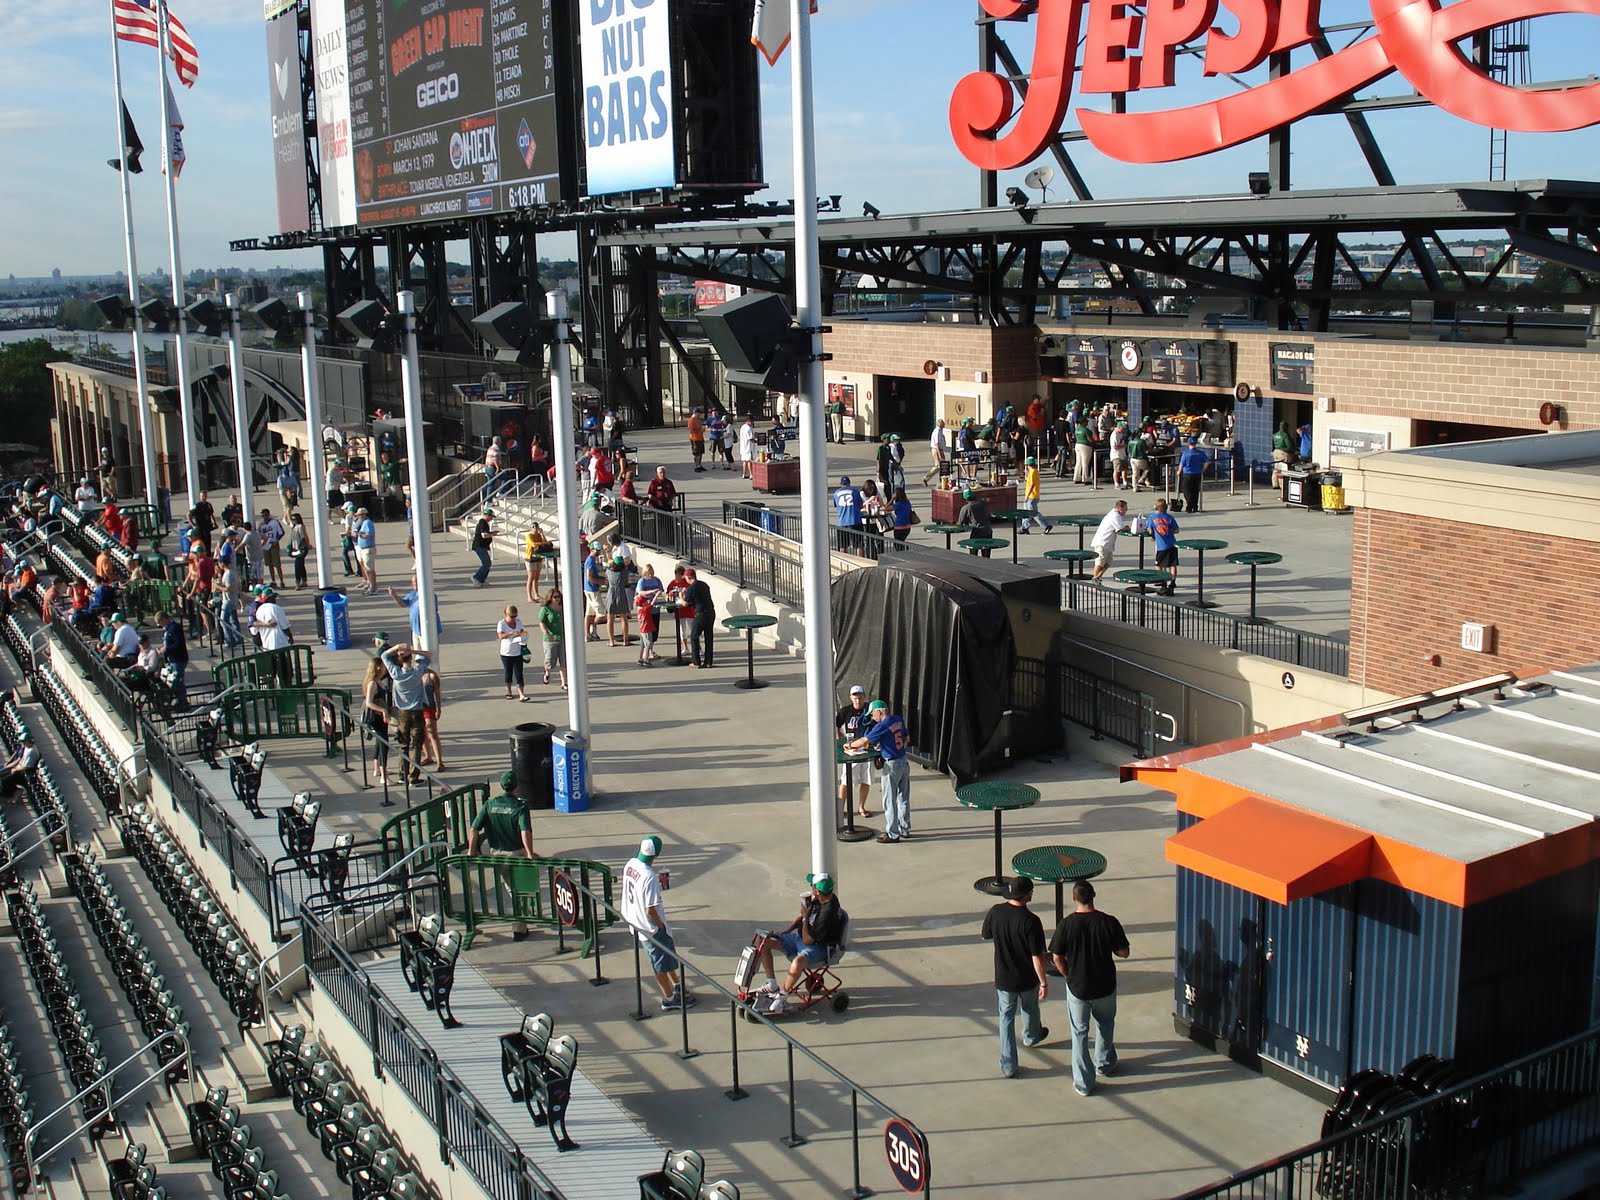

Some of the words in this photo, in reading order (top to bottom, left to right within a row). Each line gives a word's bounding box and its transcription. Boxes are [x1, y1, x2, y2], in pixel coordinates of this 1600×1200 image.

[315, 27, 342, 58] DAILY
[391, 25, 422, 77] GREEN
[423, 14, 446, 56] CAP
[448, 8, 484, 49] NIGHT
[500, 22, 528, 44] MARTINEZ
[502, 45, 519, 62] THOLE
[601, 16, 646, 77] NUT
[317, 64, 345, 93] NEWS
[502, 63, 523, 81] TEJADA
[416, 72, 460, 109] GEICO
[586, 70, 669, 148] BARS
[272, 109, 301, 138] Emblem
[393, 136, 412, 154] JOHAN
[411, 130, 439, 151] SANTANA
[393, 159, 412, 176] MARCH
[421, 153, 435, 169] 1979
[481, 162, 499, 183] SHOW
[445, 171, 475, 188] VENEZUELA
[508, 185, 529, 208] 6:18
[530, 182, 546, 205] PM
[420, 200, 446, 216] LUNCHBOX
[446, 198, 462, 212] NIGHT
[776, 427, 799, 436] TOPPING
[1330, 437, 1352, 447] VICTORY
[1352, 440, 1365, 448] CAN
[959, 449, 990, 458] TOPPINGS
[1337, 446, 1356, 454] YOURS
[838, 494, 854, 507] 42
[1464, 627, 1480, 647] EXIT
[894, 730, 904, 750] 5
[556, 768, 564, 798] pepsi
[555, 882, 574, 915] 305
[628, 881, 636, 905] 5
[888, 1131, 920, 1180] 305
